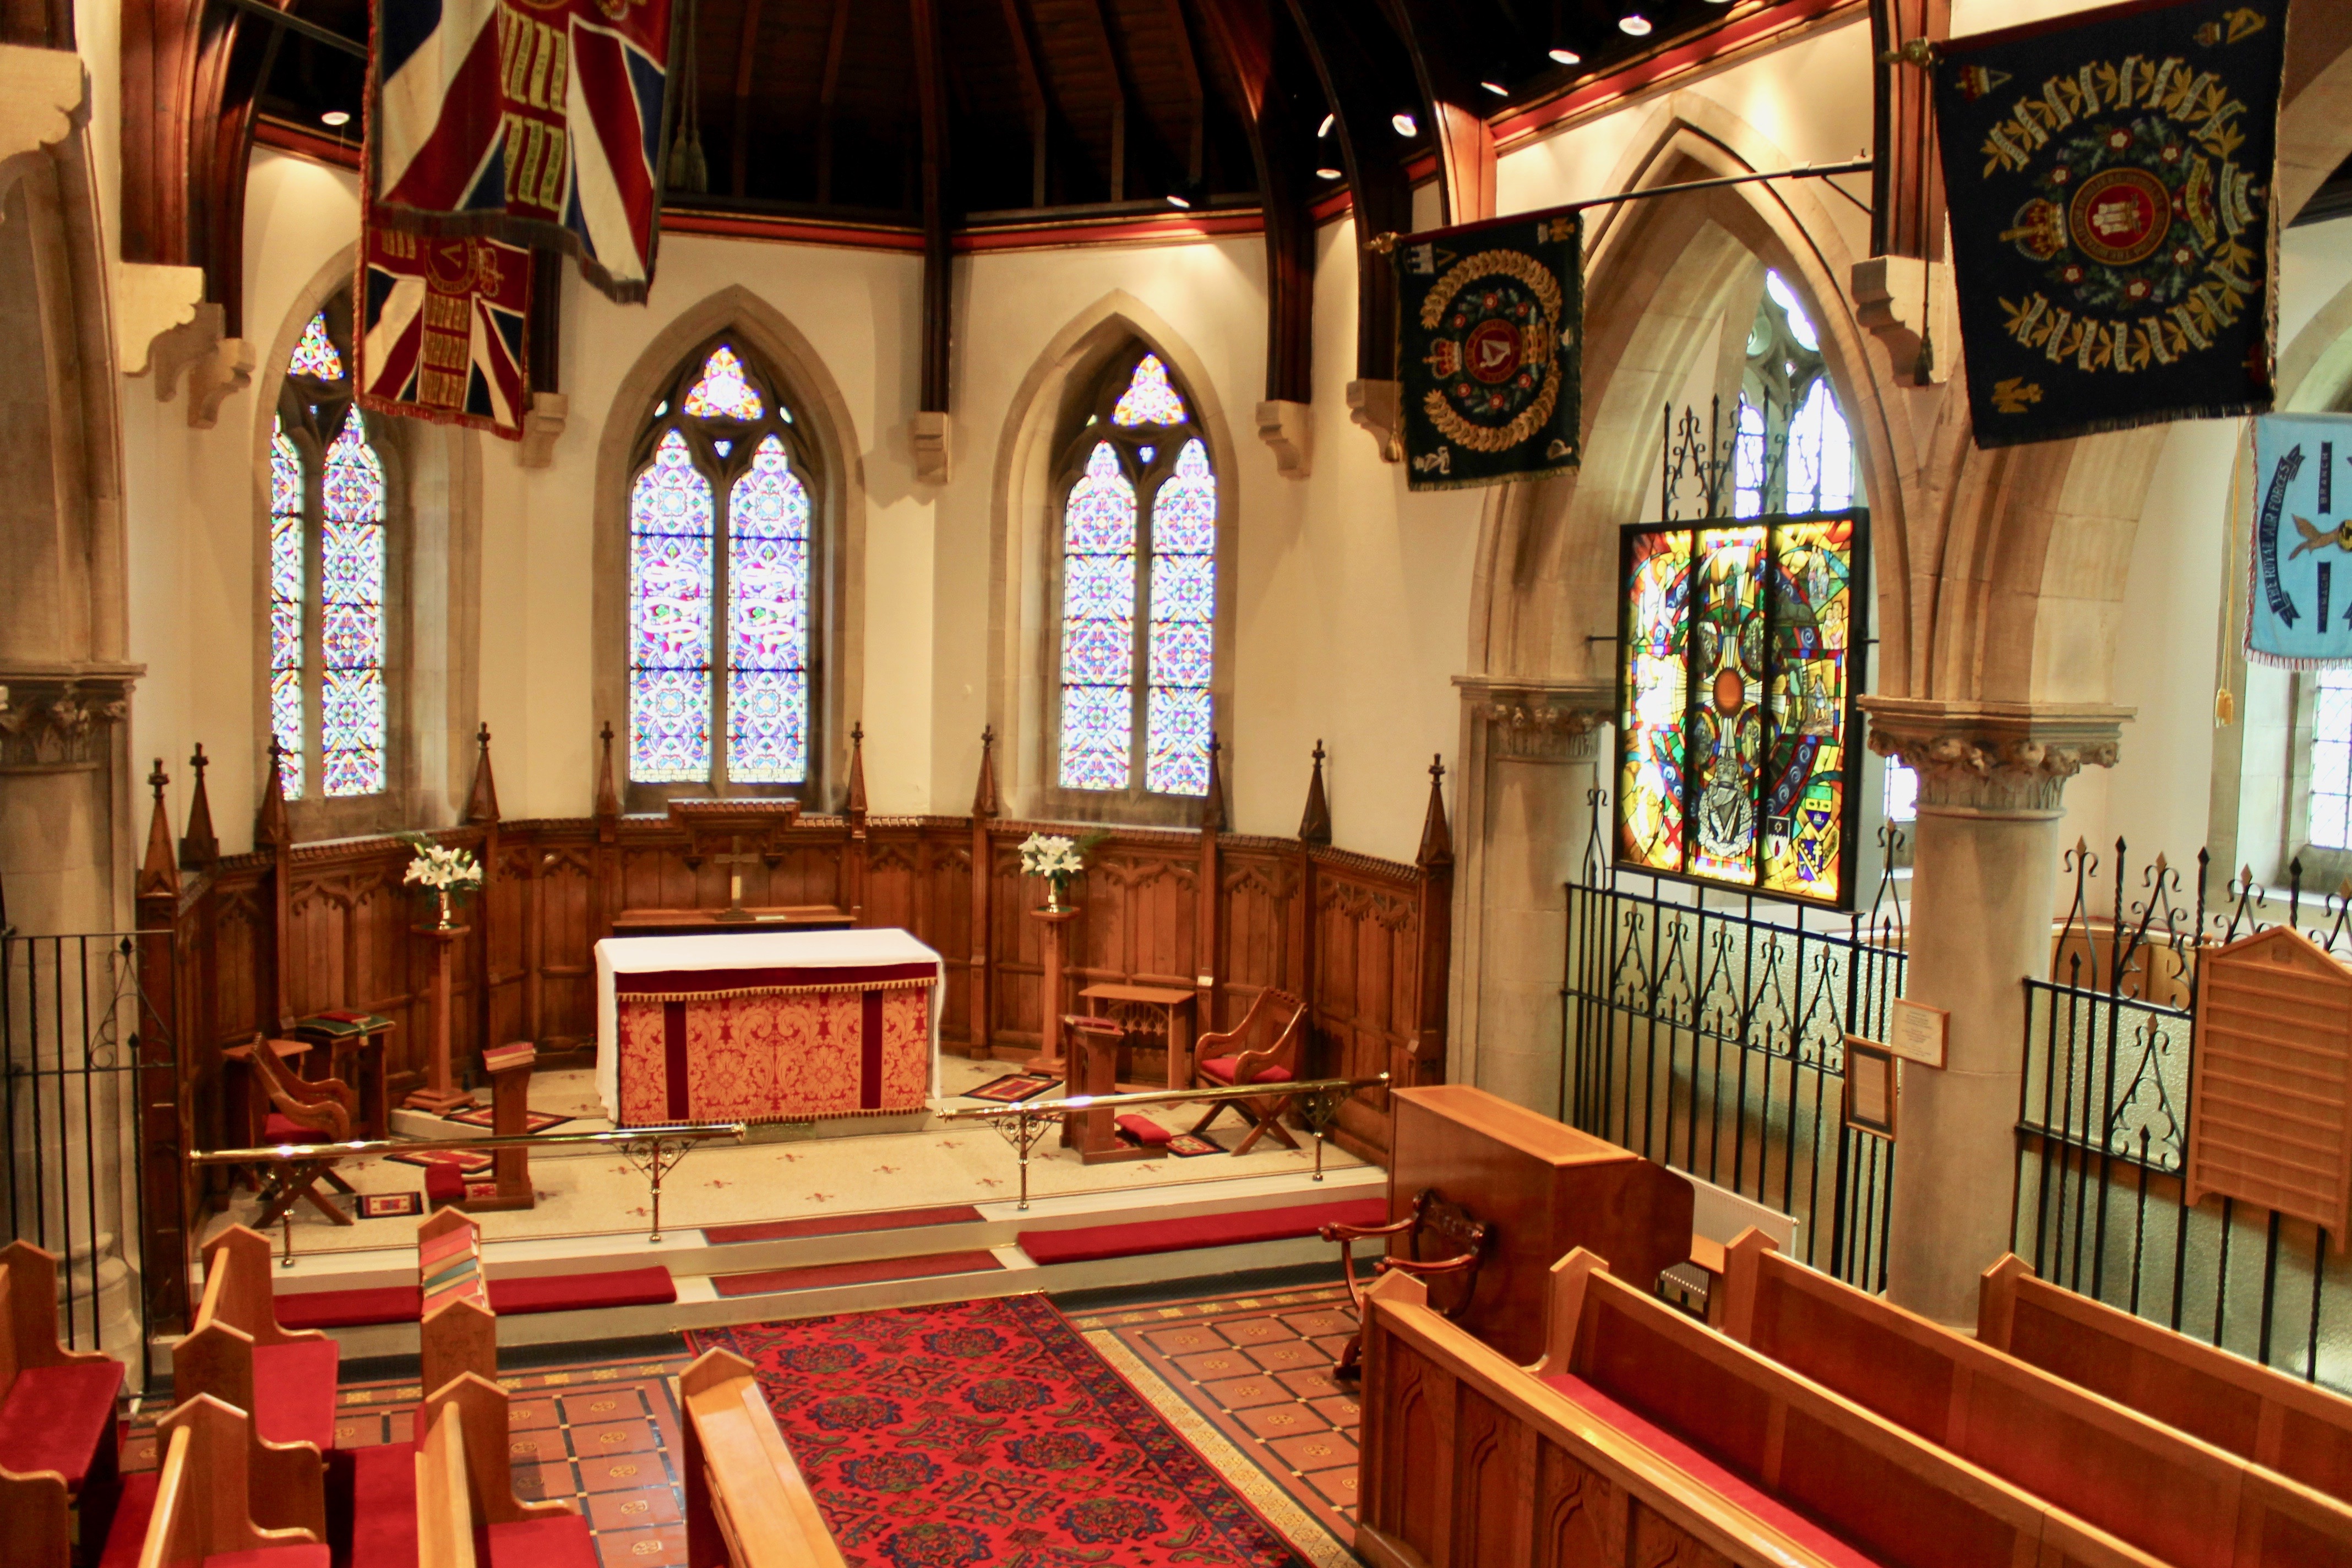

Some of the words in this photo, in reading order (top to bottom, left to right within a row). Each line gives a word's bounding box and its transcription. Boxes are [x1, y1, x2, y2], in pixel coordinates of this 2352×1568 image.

[2268, 464, 2290, 511] FORCES
[2319, 452, 2328, 504] BRANCH
[2262, 513, 2277, 536] AIR
[2262, 541, 2276, 578] ROYAL
[2266, 581, 2282, 604] THE
